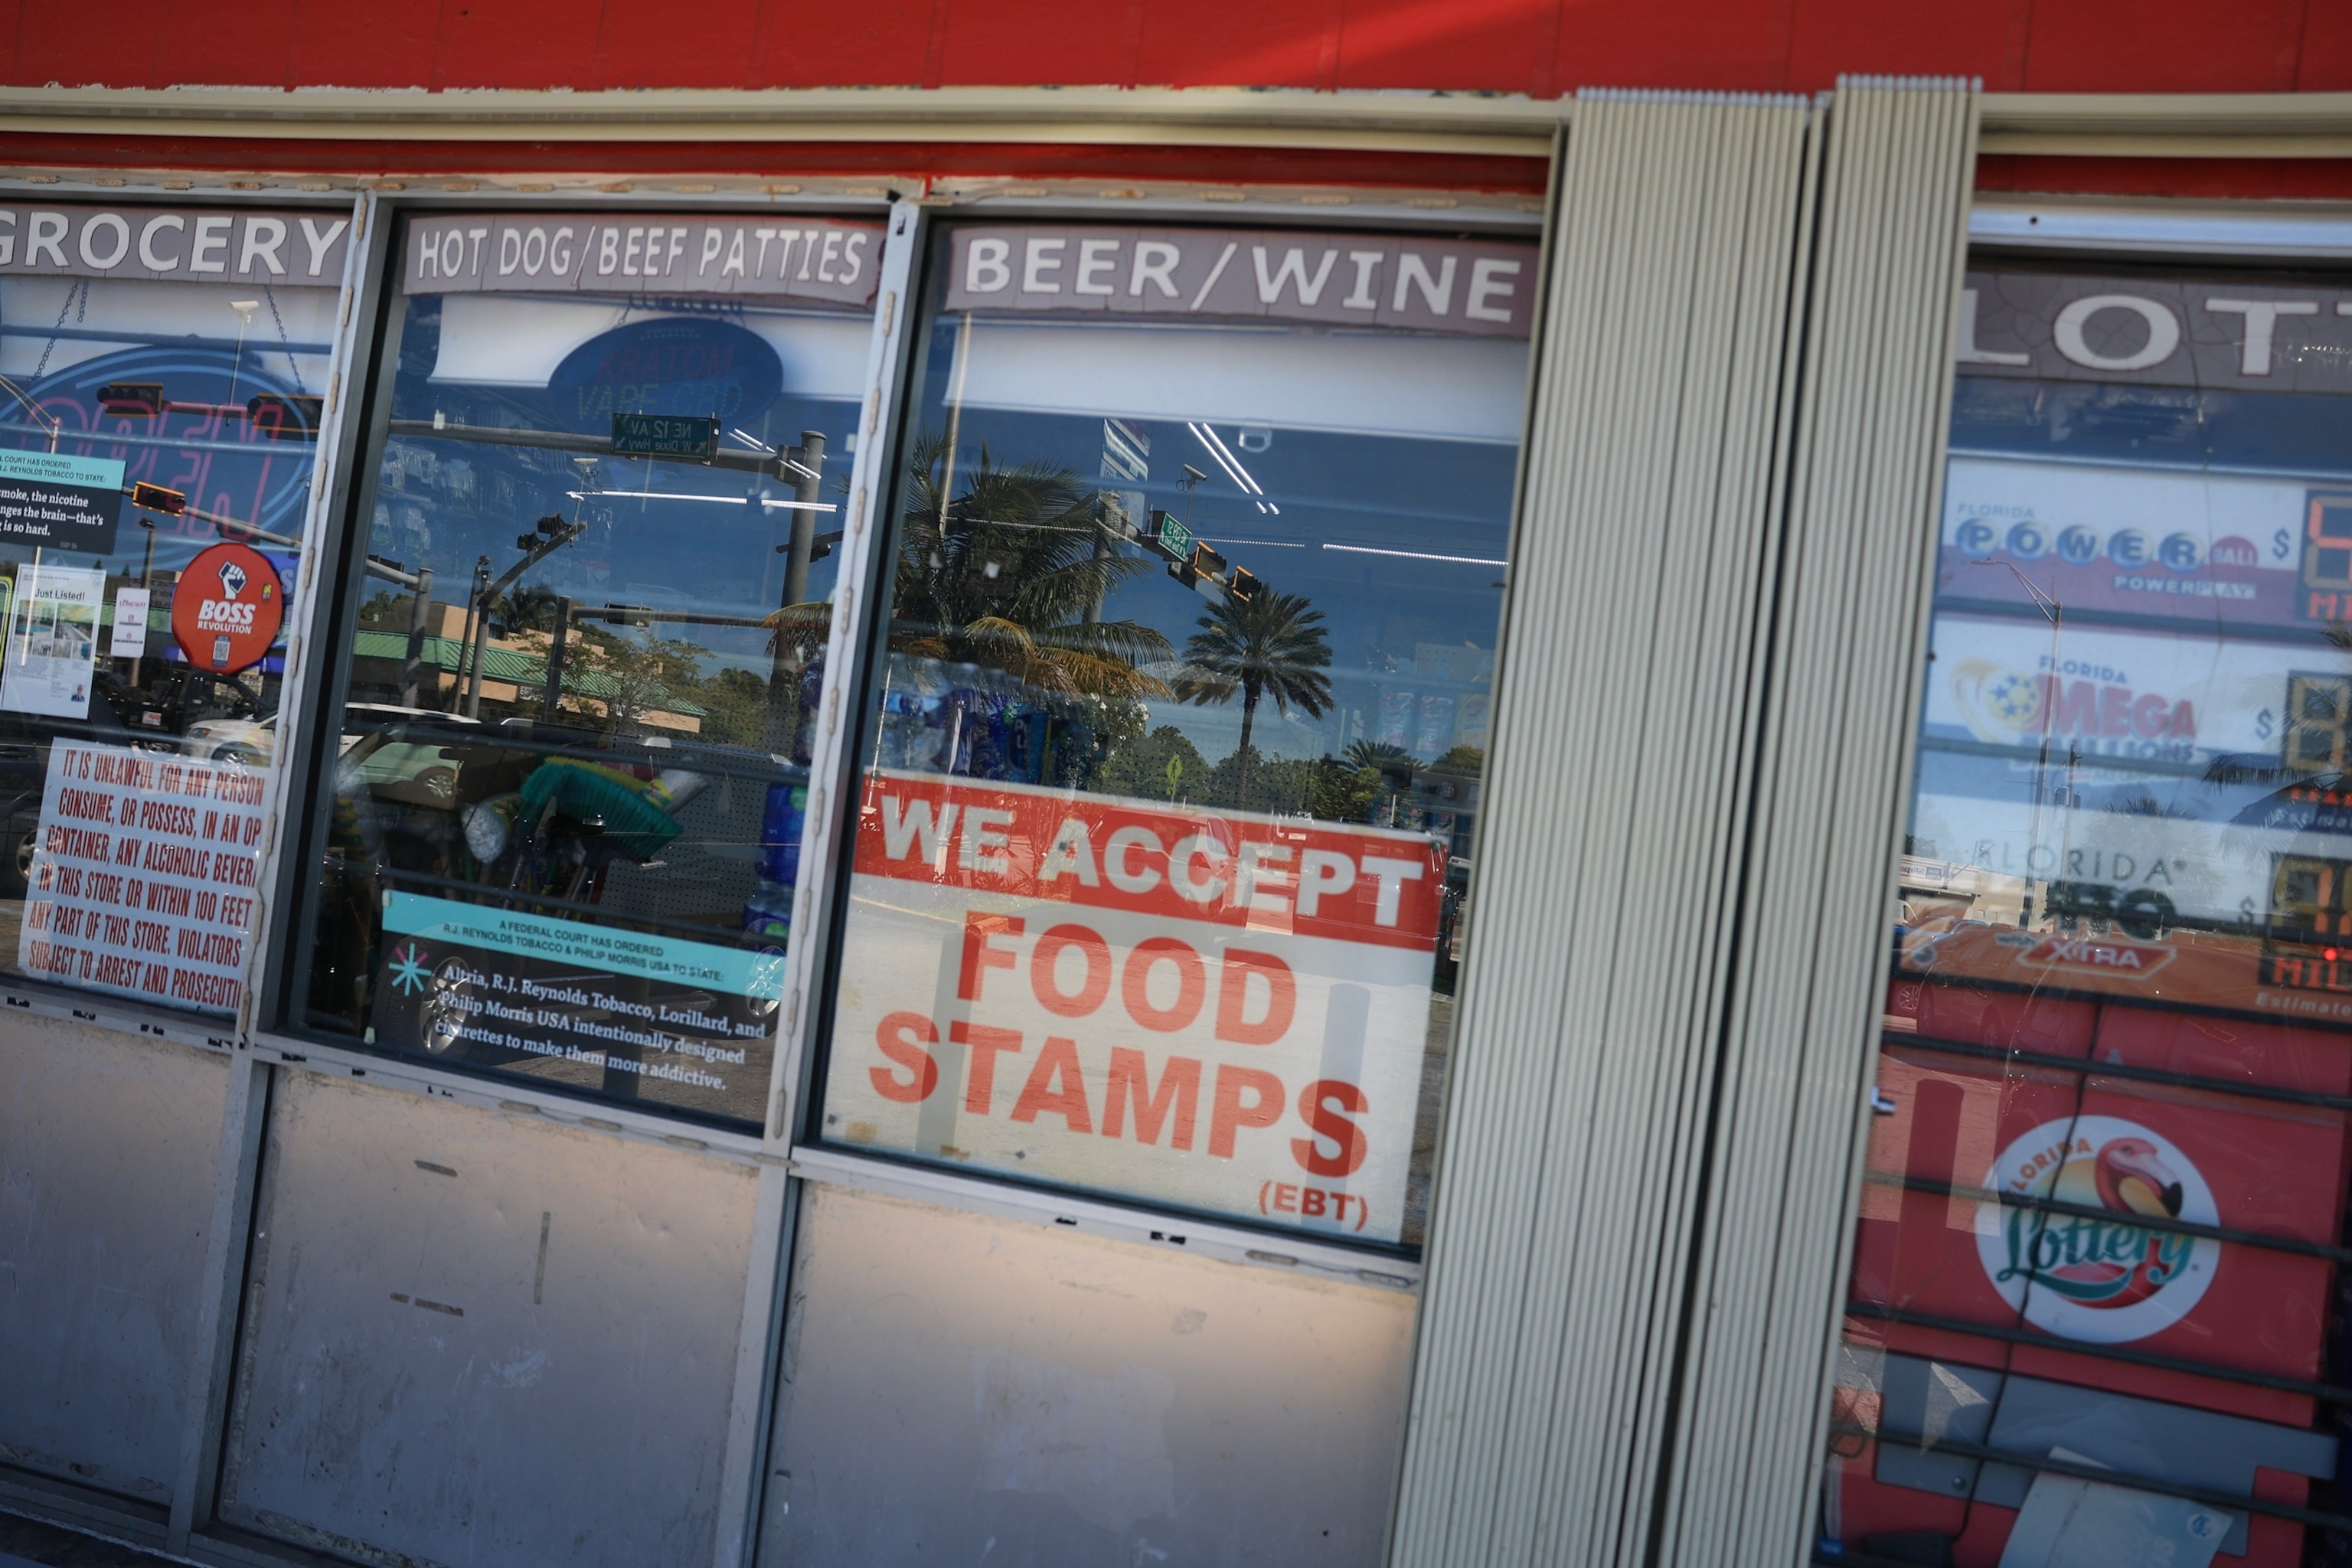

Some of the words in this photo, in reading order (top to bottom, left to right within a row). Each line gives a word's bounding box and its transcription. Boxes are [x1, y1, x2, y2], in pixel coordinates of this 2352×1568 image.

[418, 229, 487, 279] HOT
[498, 225, 688, 286] DOG/BEEF
[699, 229, 868, 286] PATTIES
[965, 238, 1521, 324] BEER/WINE
[1955, 289, 2352, 376] LOT
[596, 345, 736, 383] KRATOM
[5, 456, 27, 464] COURT
[10, 466, 43, 475] REYNOLDS
[44, 469, 74, 479] TOBACCO
[85, 475, 106, 483] STATE:
[24, 506, 39, 518] the
[31, 491, 47, 502] the
[49, 493, 89, 508] nicotine
[1957, 503, 2036, 520] FLORIDA
[4, 520, 11, 531] is
[14, 524, 24, 533] so
[25, 523, 51, 537] hard.
[34, 589, 53, 599] Just
[55, 590, 85, 601] Listed!
[198, 599, 256, 625] BOSS
[198, 621, 253, 635] REVOLUTION
[2039, 656, 2128, 684] FLORIDA
[2029, 673, 2197, 740] MEGA
[62, 749, 77, 778] IT
[77, 750, 92, 781] IS
[93, 753, 154, 789] UNLAWFUL
[157, 763, 182, 794] FOR
[185, 766, 211, 799] ANY
[213, 770, 265, 806] PERSON
[58, 787, 115, 828] CONSUME,
[120, 797, 137, 828] OR
[140, 800, 197, 841] POSSESS,
[203, 810, 218, 840] IN
[220, 814, 240, 843] AN
[46, 825, 111, 867] CONTAINER,
[116, 837, 142, 867] ANY
[144, 841, 210, 880] ALCOHOLIC
[880, 795, 1018, 877] WE
[1037, 818, 1426, 928] ACCEPT
[1975, 838, 2173, 886] FLORIDA
[38, 863, 52, 892] IN
[56, 866, 82, 897] THIS
[85, 871, 123, 905] STORE
[126, 878, 142, 909] OR
[146, 880, 191, 917] WITHIN
[194, 890, 216, 923] 100
[220, 894, 253, 927] FEET
[28, 900, 53, 929] ANY
[53, 905, 84, 938] PART
[85, 911, 100, 940] OF
[103, 913, 129, 947] THIS
[132, 920, 171, 955] STORE.
[177, 927, 242, 969] VIOLATORS
[443, 924, 459, 934] R.J.
[462, 927, 513, 944] REYNOLDS
[515, 936, 563, 953] TOBACCO
[565, 946, 572, 955] &
[574, 949, 606, 959] PHILIP
[608, 953, 647, 968] MORRIS
[649, 962, 670, 972] USA
[673, 964, 685, 975] TO
[688, 967, 725, 982] STATE:
[499, 920, 507, 929] A
[508, 923, 553, 938] FEDERAL
[555, 929, 589, 943] COURT
[591, 935, 612, 949] HAS
[614, 940, 664, 957] ORDERED
[2050, 939, 2141, 969] XTRA
[28, 939, 77, 975] SUBJECT
[78, 949, 93, 980] TO
[95, 953, 142, 991] ARREST
[142, 965, 166, 995] AND
[956, 910, 1298, 1047] FOOD
[441, 992, 483, 1017] Philip
[485, 1001, 534, 1024] Morris
[537, 1011, 570, 1031] USA
[573, 1017, 673, 1054] intentionally
[675, 1038, 745, 1065] designed
[443, 965, 489, 990] Altria,
[492, 974, 518, 994] R.J.
[521, 979, 589, 1006] Reynolds
[591, 992, 656, 1022] Tobacco,
[659, 1004, 733, 1036] Lorillard,
[735, 1023, 766, 1039] and
[506, 1034, 521, 1049] to
[523, 1037, 563, 1057] make
[566, 1045, 606, 1066] them
[608, 1054, 648, 1073] more
[649, 1063, 727, 1091] addictive.
[868, 1011, 1370, 1179] STAMPS
[1259, 1180, 1369, 1231] (EBT)
[1995, 1207, 2196, 1300] Lottery
